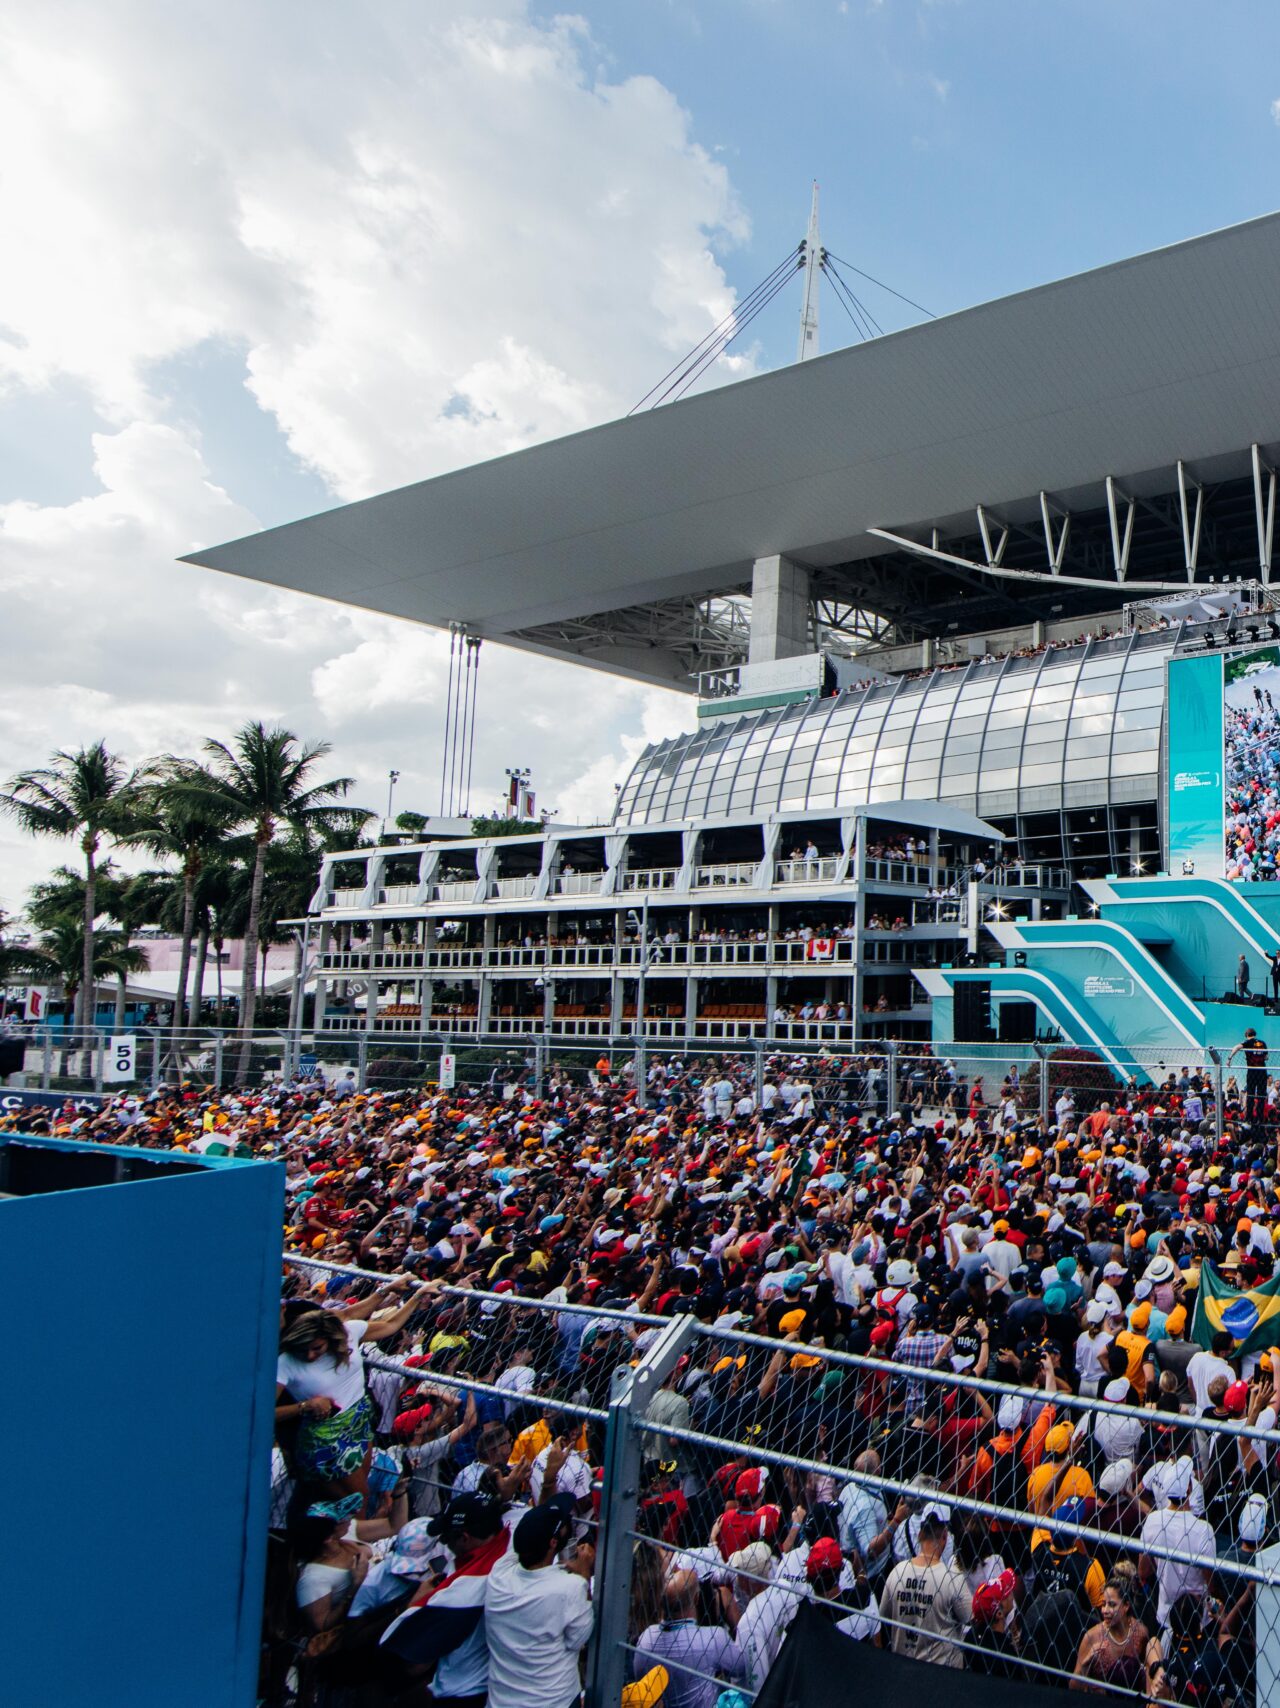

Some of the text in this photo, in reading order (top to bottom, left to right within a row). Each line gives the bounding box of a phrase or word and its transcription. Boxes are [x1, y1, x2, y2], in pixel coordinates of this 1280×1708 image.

[116, 1045, 131, 1072] 50
[906, 1578, 918, 1589] DO
[897, 1591, 933, 1604] FOR YOUR
[899, 1606, 927, 1618] PLANET
